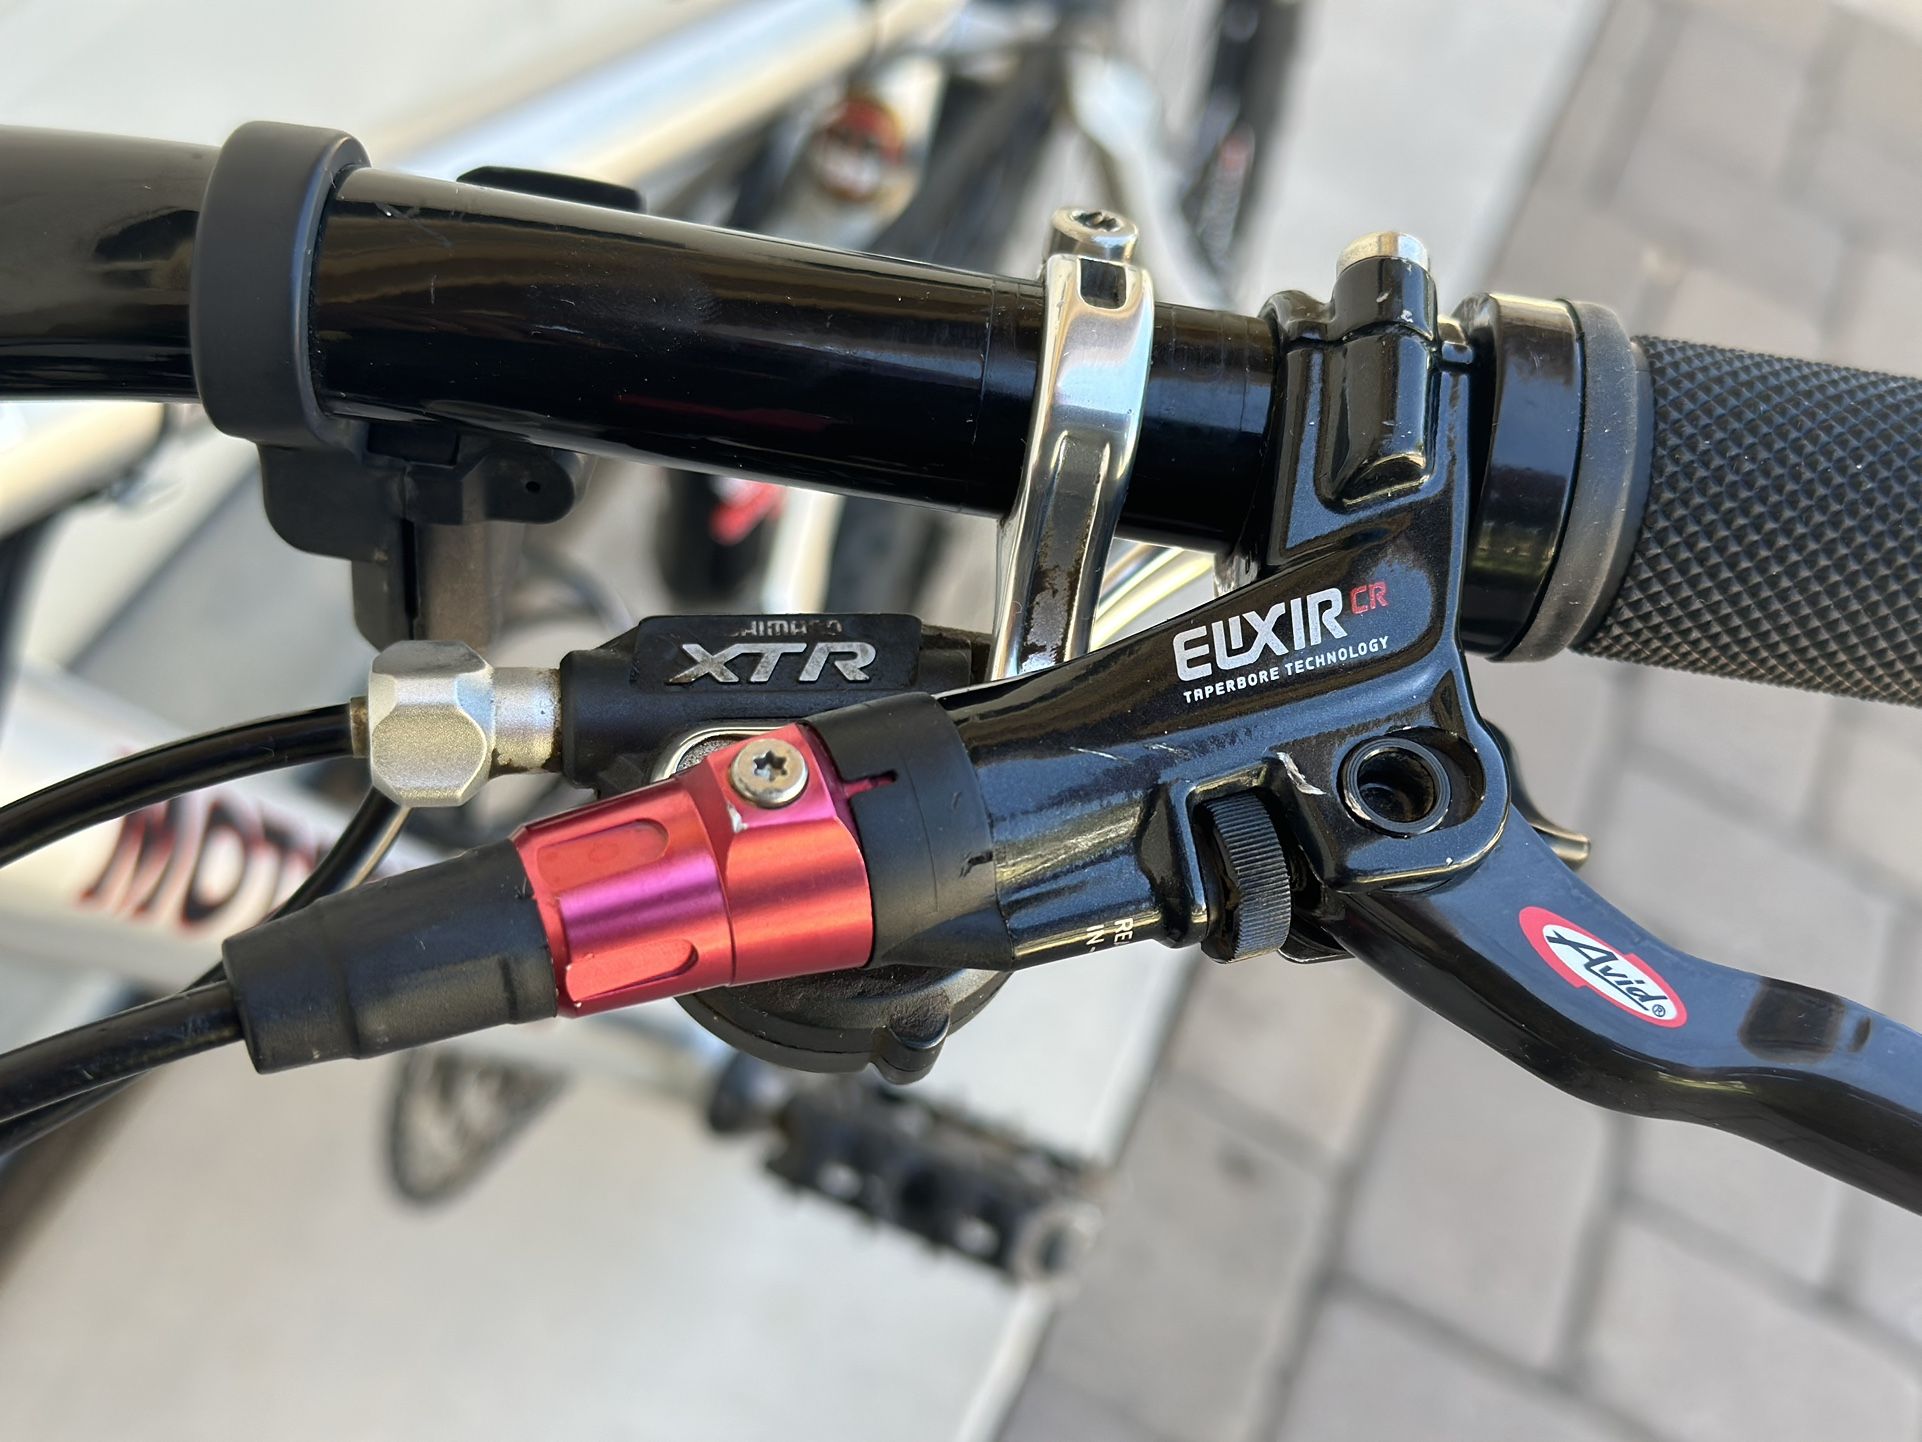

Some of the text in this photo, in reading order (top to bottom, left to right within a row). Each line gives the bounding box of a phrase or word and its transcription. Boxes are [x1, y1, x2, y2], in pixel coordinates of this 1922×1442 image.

[665, 642, 876, 683] XTR
[1173, 581, 1388, 682] ELIXIR CR
[1183, 635, 1389, 703] TAPERBORE TECHNOLOGY
